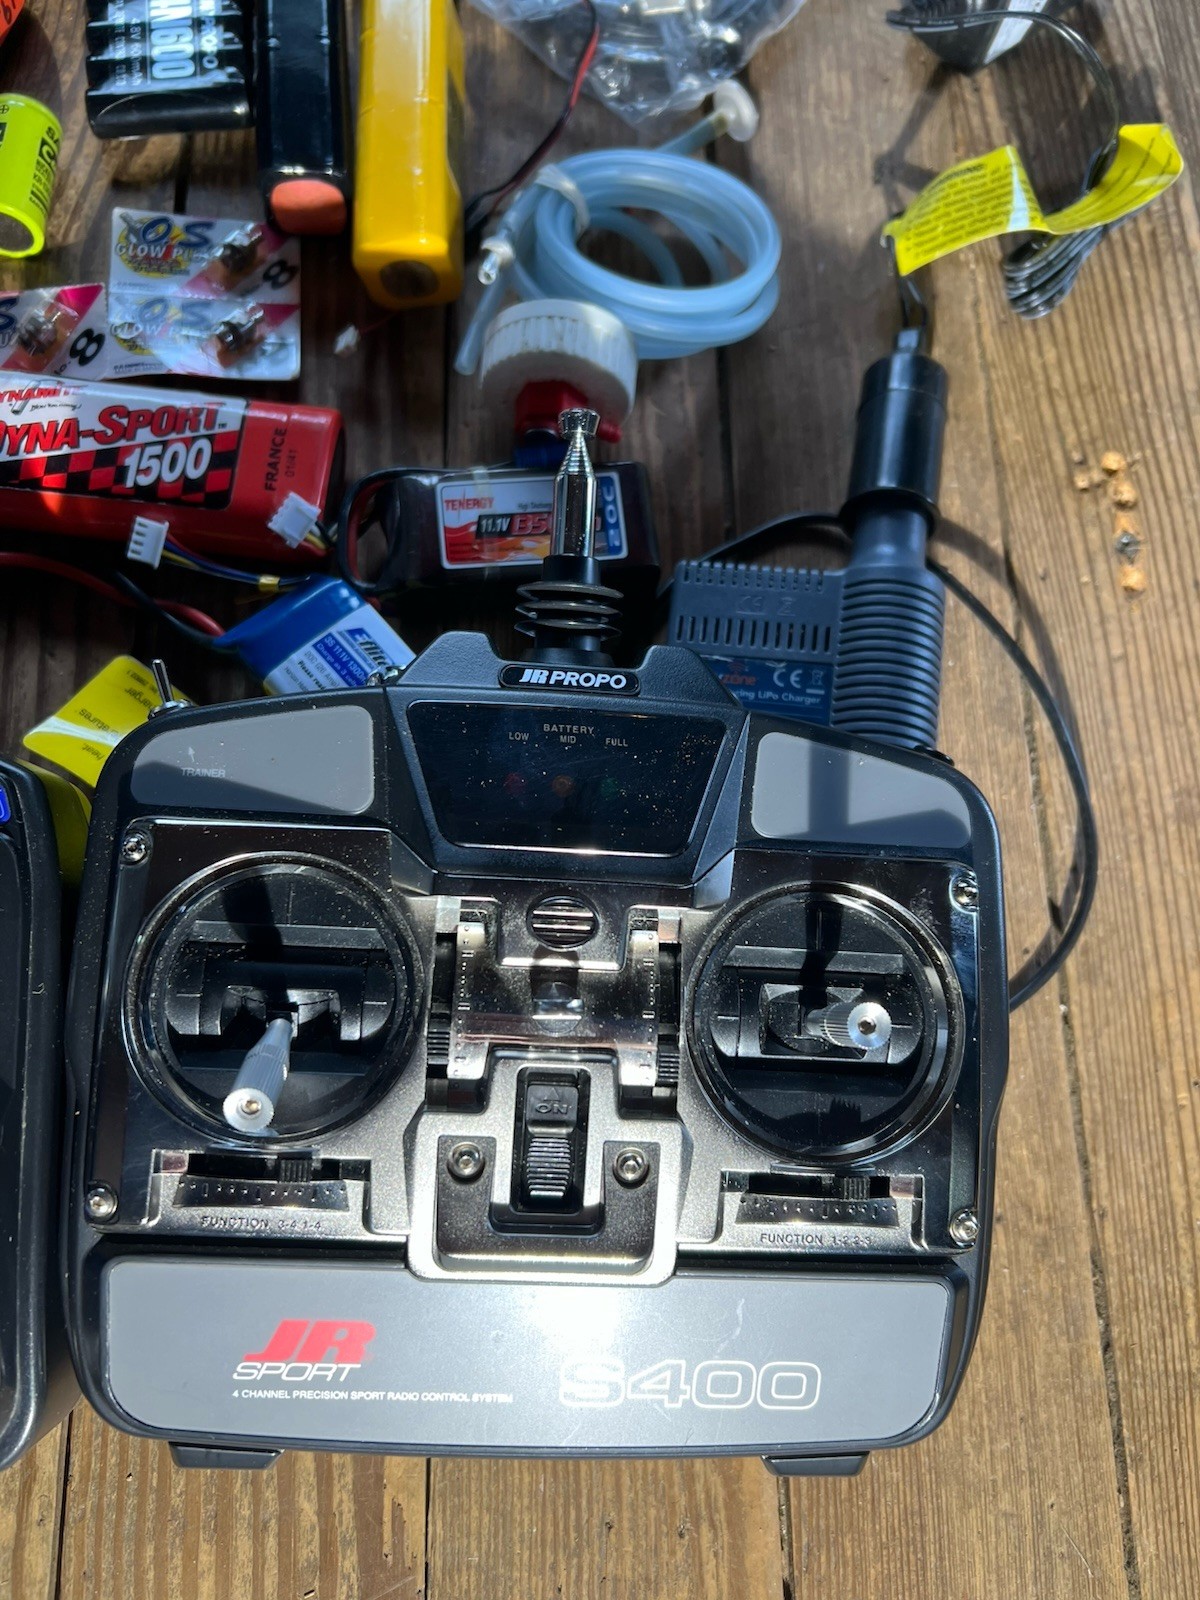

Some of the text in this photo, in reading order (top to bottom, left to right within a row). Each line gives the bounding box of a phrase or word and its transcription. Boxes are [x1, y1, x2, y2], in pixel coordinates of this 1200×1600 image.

[69, 328, 106, 367] 8
[122, 437, 213, 489] 1500
[265, 428, 288, 491] FRANCE
[444, 496, 494, 512] TENERGY
[519, 668, 627, 689] JR PROPO
[781, 692, 820, 705] Charger
[543, 723, 595, 734] BATTERY
[508, 731, 629, 747] LOW MID FULL
[180, 767, 226, 778] TRAINER
[535, 1102, 568, 1115] ON
[200, 1215, 269, 1230] FUNCTION
[760, 1233, 823, 1245] FUNCTION
[243, 1318, 377, 1363] JR
[232, 1361, 362, 1382] SPORT
[559, 1355, 822, 1411] S400
[232, 1389, 514, 1404] 4 CHANNEL PRECISION SPORT RADIO CONTROL SYSTEM
